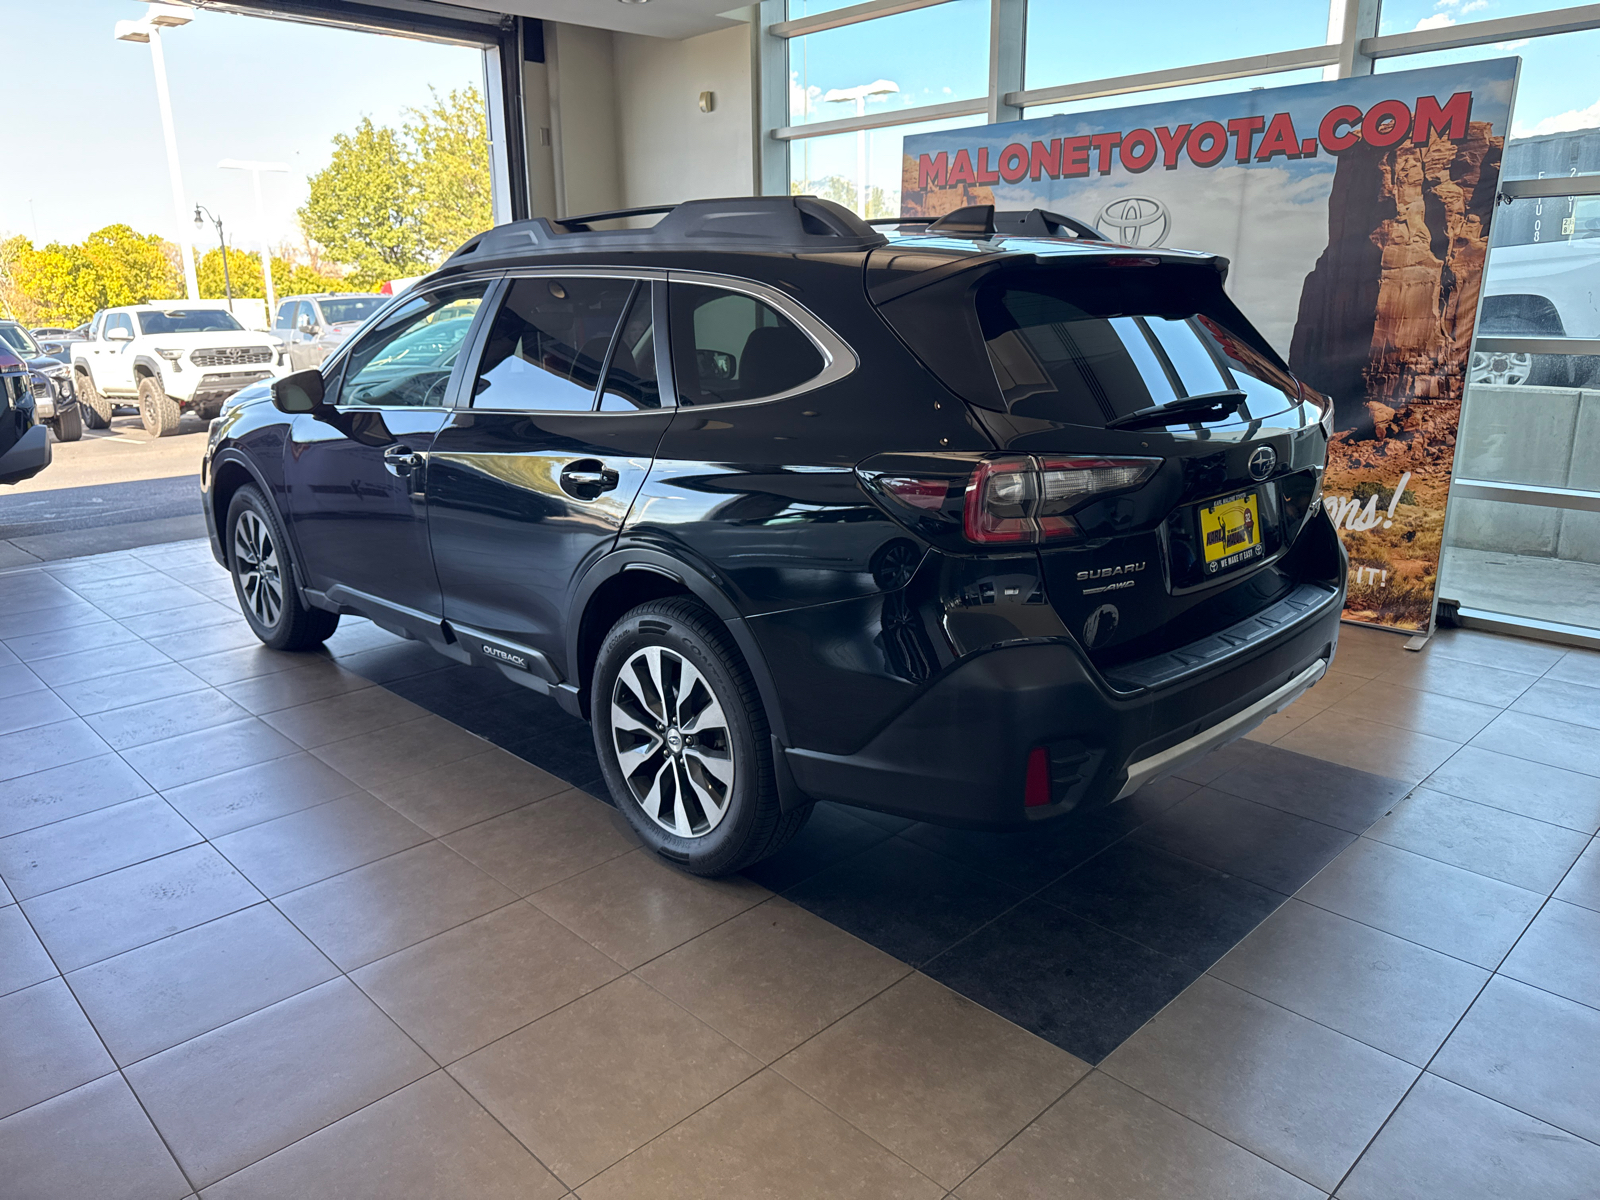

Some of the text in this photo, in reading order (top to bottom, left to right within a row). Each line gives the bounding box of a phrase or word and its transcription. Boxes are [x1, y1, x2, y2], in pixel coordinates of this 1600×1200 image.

[917, 91, 1474, 190] MALONETOYOTA.COM
[1221, 559, 1228, 568] WE
[1243, 549, 1253, 559] EASY
[1076, 561, 1146, 581] SUBARU
[1356, 566, 1388, 588] IT!
[483, 645, 526, 666] OUTBACK
